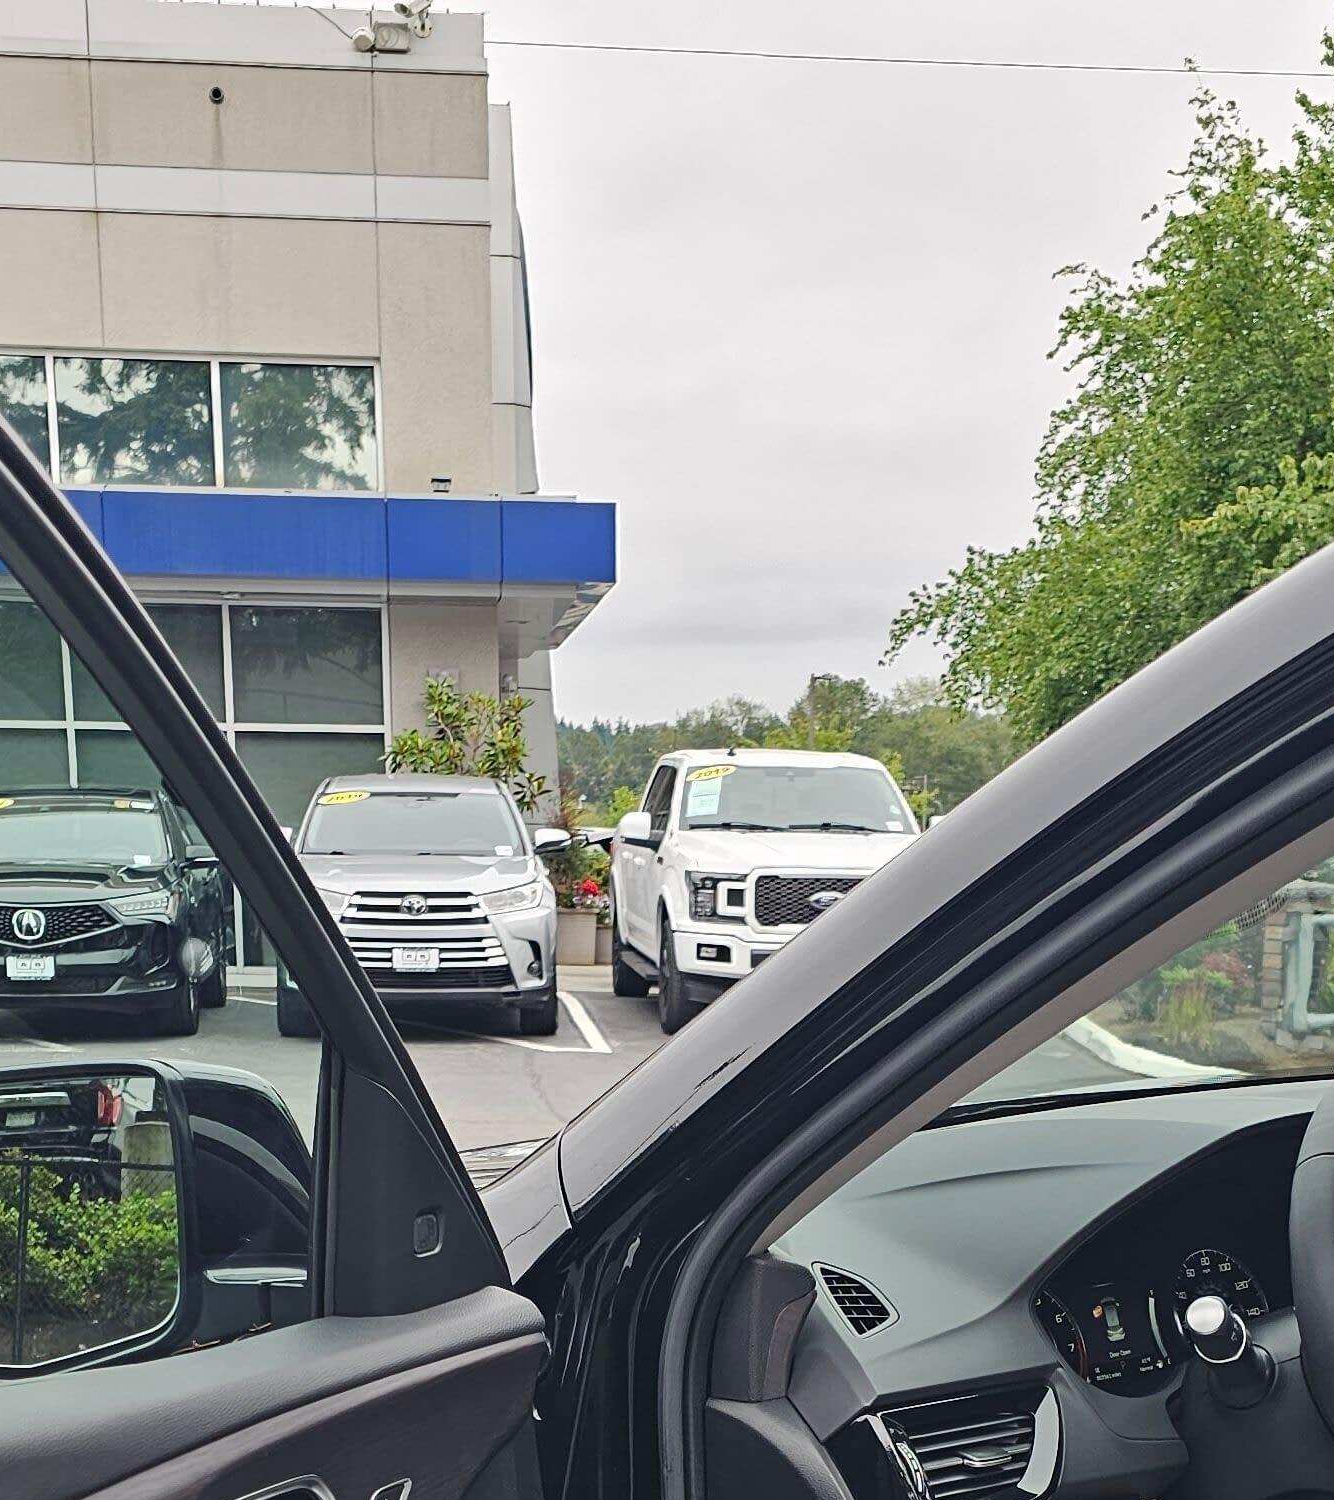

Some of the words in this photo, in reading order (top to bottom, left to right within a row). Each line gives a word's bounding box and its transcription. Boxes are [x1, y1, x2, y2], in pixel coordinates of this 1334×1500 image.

[1200, 1256, 1210, 1266] 80
[1218, 1262, 1231, 1272] 100
[1185, 1268, 1196, 1278] 60
[1234, 1280, 1248, 1290] 120
[1055, 1314, 1063, 1324] 6
